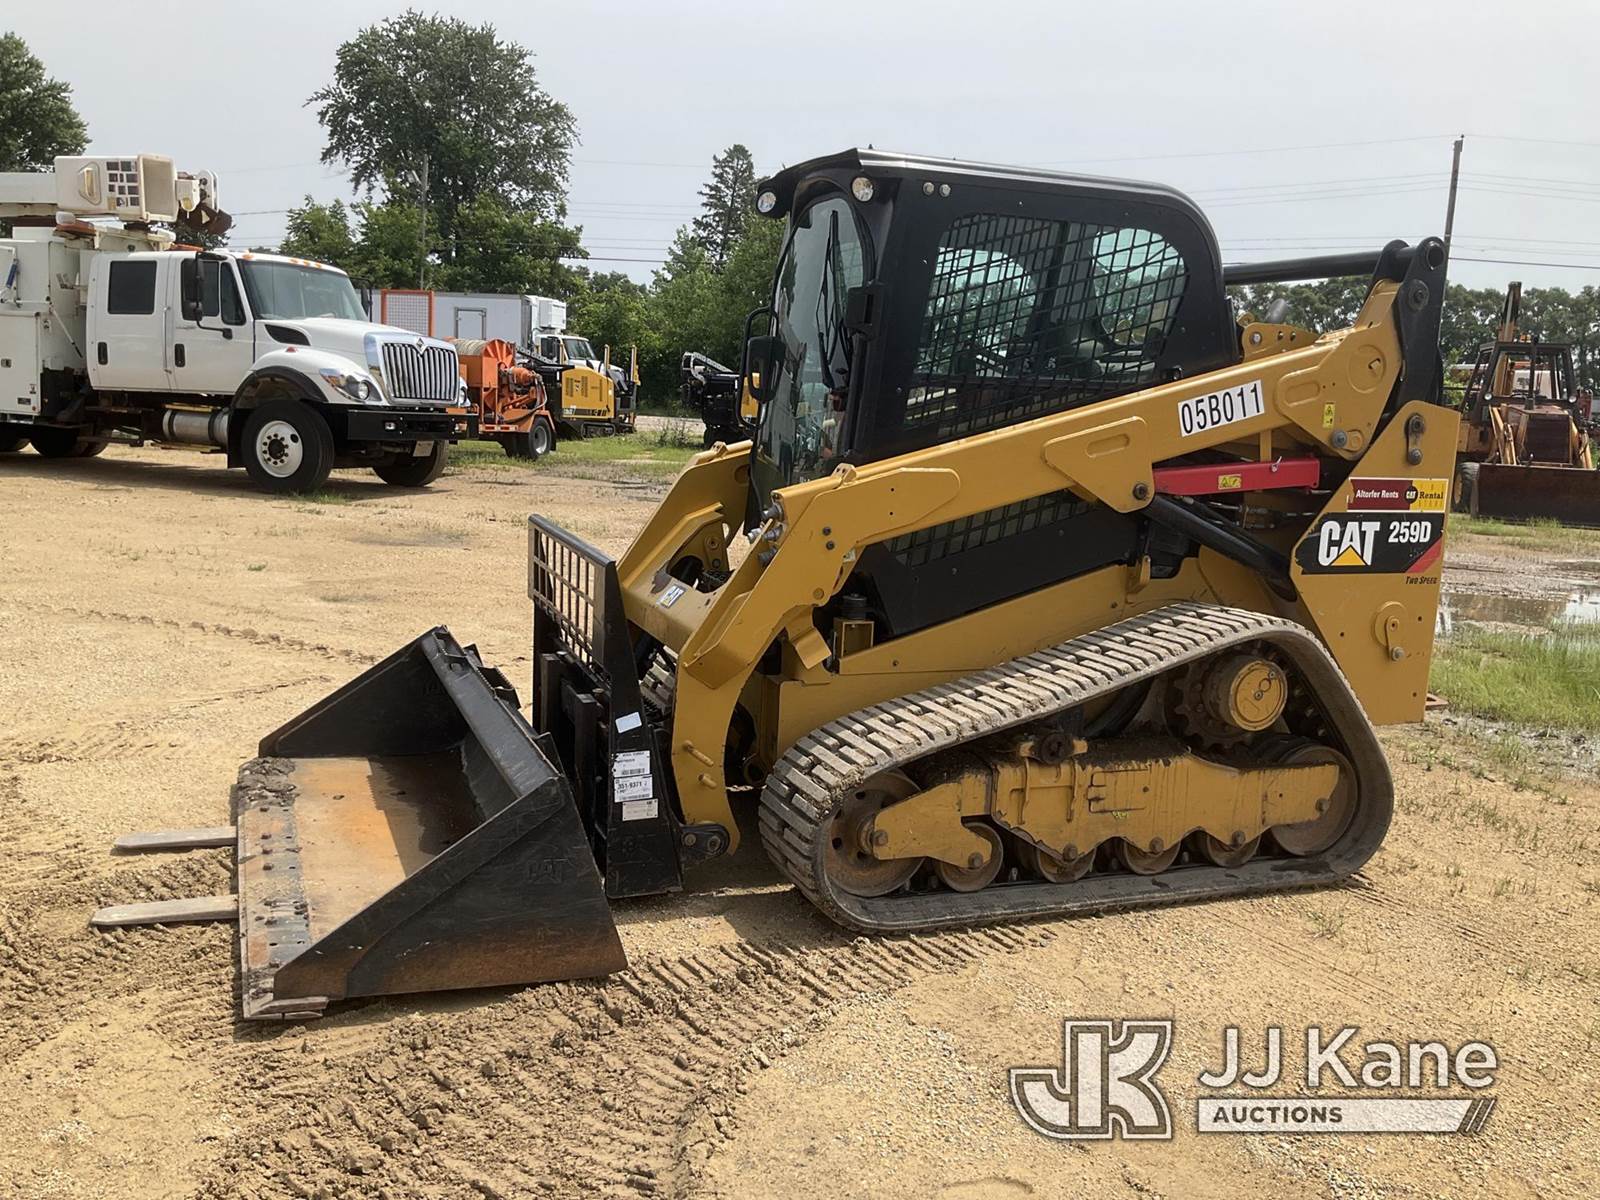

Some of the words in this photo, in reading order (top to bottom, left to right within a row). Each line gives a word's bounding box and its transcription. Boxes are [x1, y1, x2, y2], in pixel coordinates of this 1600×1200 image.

[1181, 383, 1260, 434] 05B011
[1355, 489, 1381, 498] Altorfer
[1381, 489, 1399, 499] Rents
[1405, 491, 1417, 499] CAT
[1419, 490, 1444, 500] Rental
[1318, 520, 1381, 567] CAT
[1388, 521, 1432, 543] 259D
